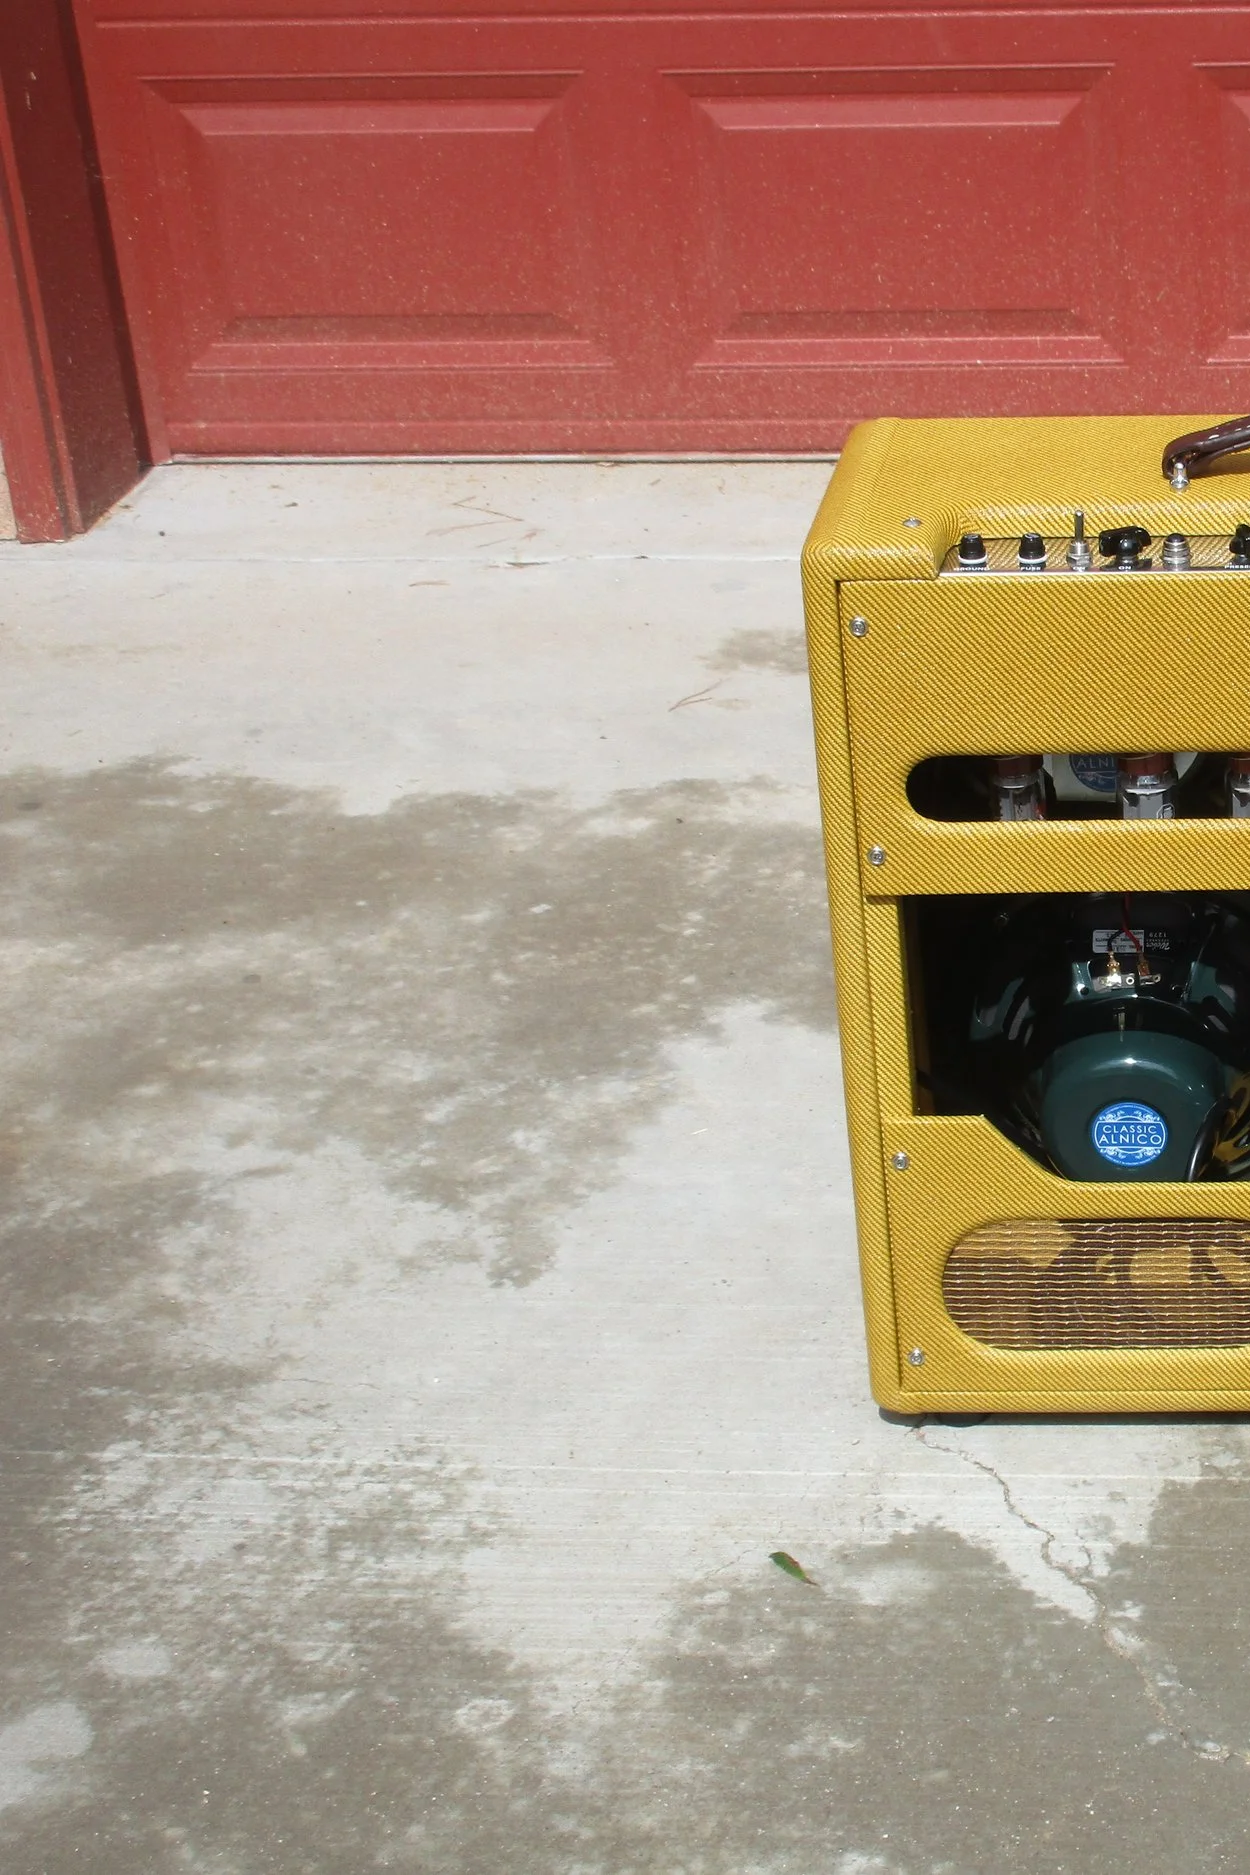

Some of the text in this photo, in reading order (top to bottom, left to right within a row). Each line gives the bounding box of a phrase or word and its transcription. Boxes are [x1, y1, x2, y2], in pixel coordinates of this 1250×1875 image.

[1076, 757, 1115, 769] ALNI
[1102, 1125, 1157, 1134] CLASSIC
[1098, 1133, 1162, 1145] ALNICO
